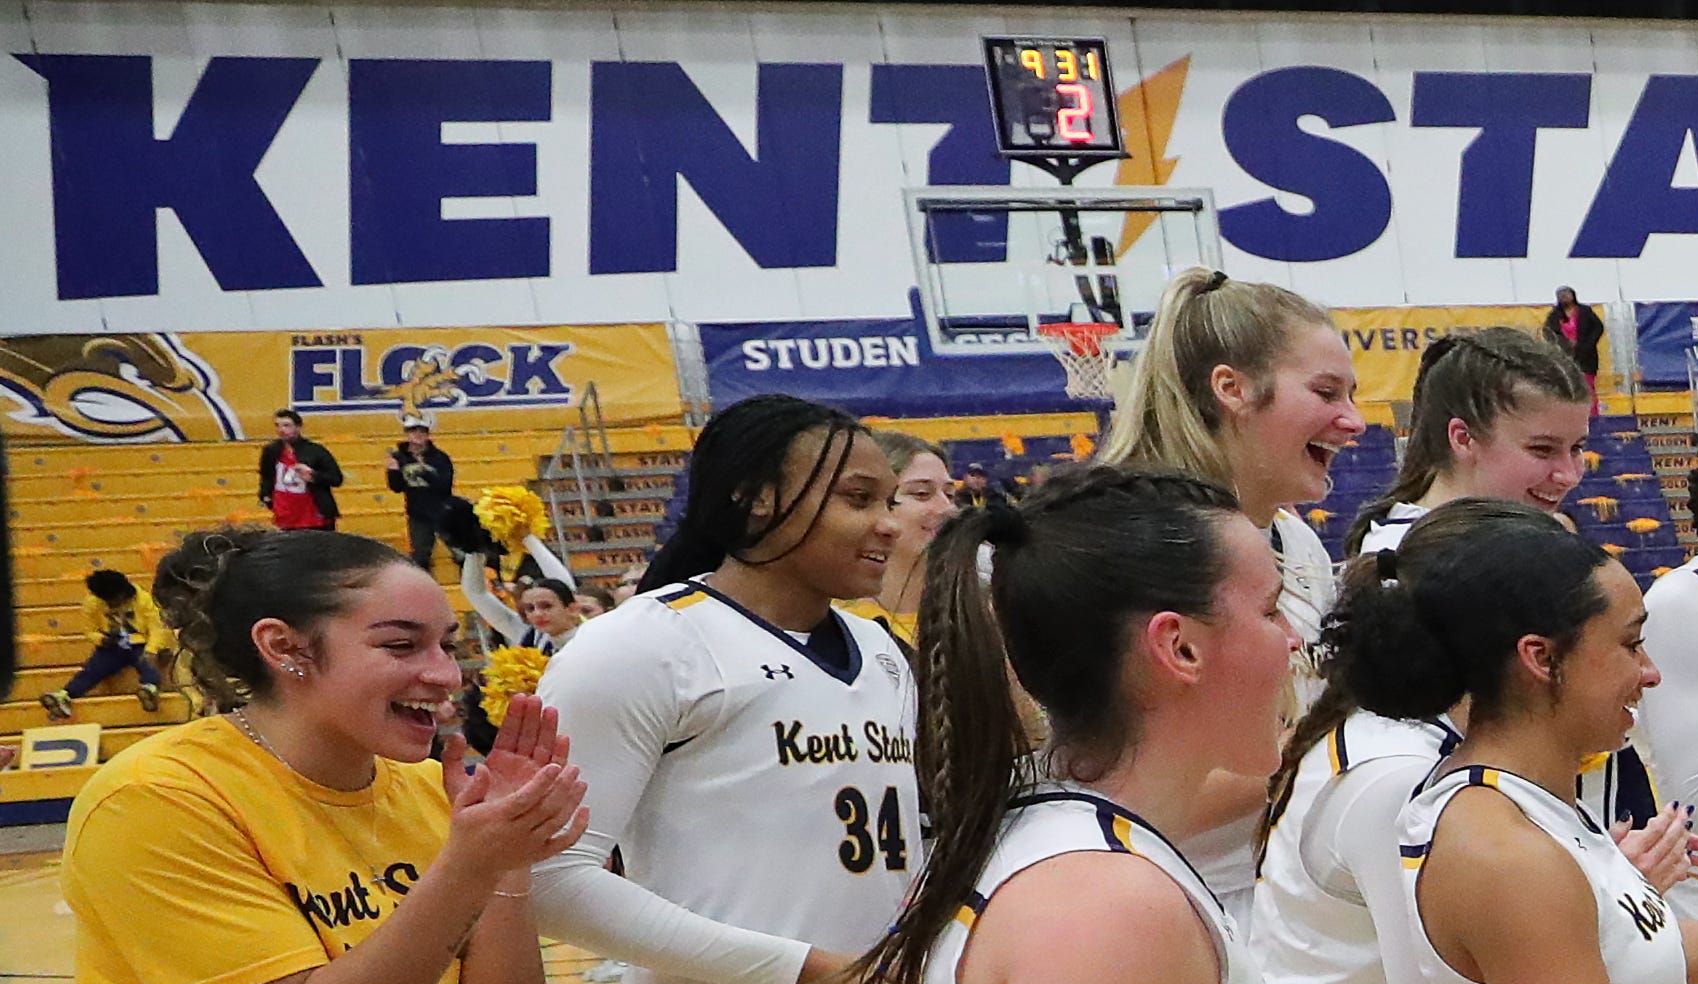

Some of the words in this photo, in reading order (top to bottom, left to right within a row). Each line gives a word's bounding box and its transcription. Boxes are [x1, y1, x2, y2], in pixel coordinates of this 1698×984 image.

[1055, 84, 1095, 143] 2
[11, 52, 1012, 301] KENT
[290, 334, 364, 347] FLASH'S
[741, 335, 921, 371] STUDEN
[292, 344, 574, 403] FLOCK
[772, 719, 860, 767] Kent
[833, 785, 907, 875] 34
